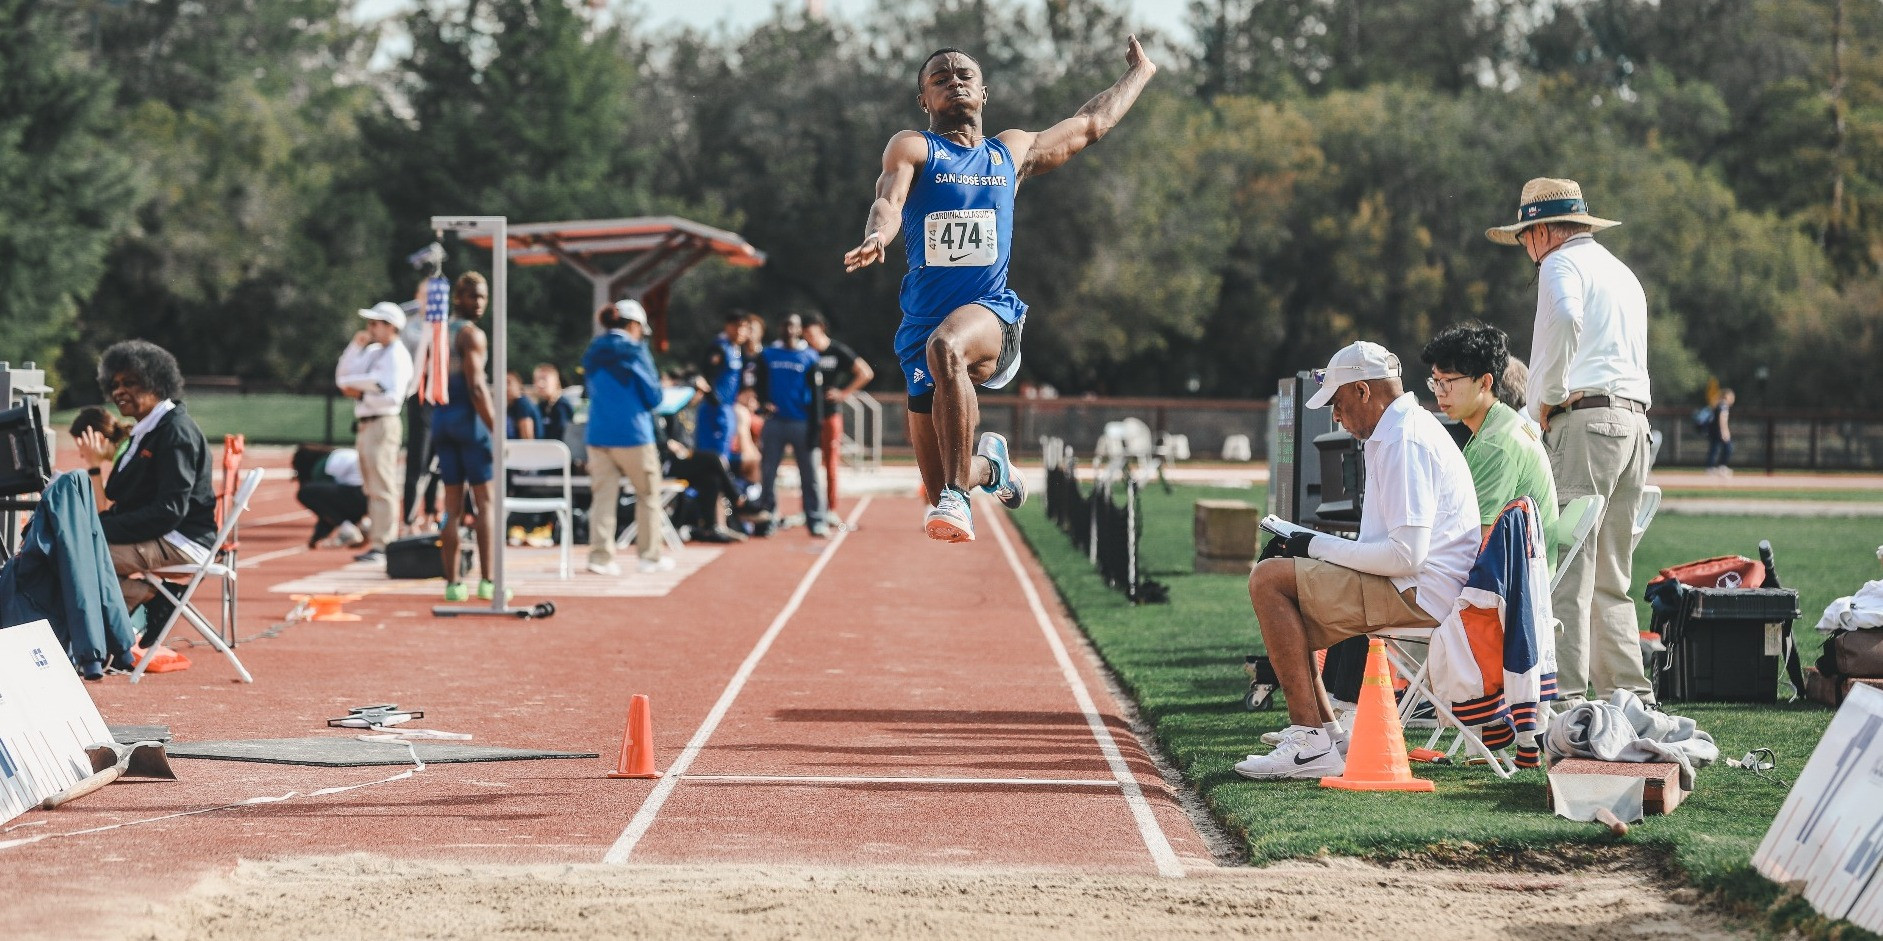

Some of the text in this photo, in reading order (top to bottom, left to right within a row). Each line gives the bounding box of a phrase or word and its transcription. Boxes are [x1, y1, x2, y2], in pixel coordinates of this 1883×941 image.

[935, 173, 1007, 187] SAN JOSÉ STATE
[930, 210, 989, 220] CARDINAL CLASSIC
[929, 229, 937, 250] 474
[941, 222, 982, 249] 474
